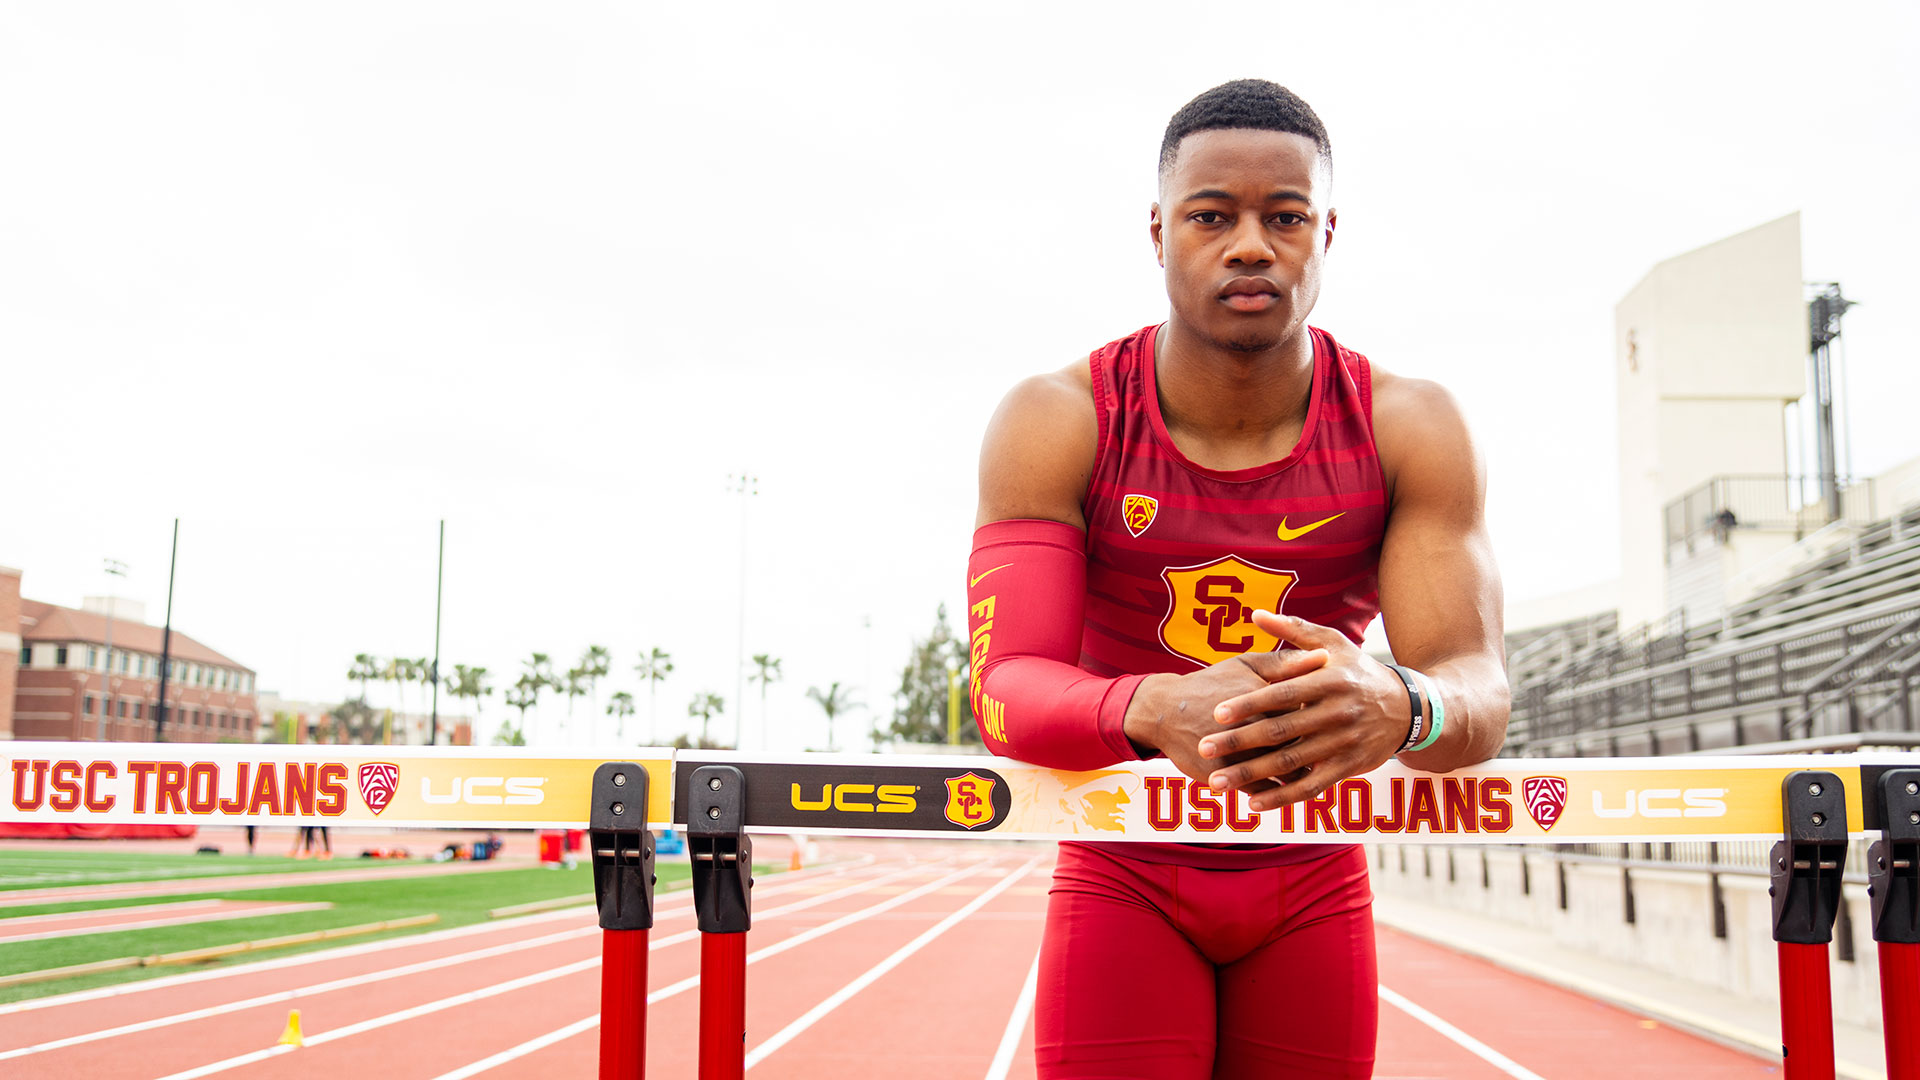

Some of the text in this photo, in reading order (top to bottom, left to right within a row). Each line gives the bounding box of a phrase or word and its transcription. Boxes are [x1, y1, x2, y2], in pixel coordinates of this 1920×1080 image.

[1125, 497, 1156, 522] PAC
[1129, 513, 1147, 529] 12
[981, 693, 1008, 744] ON!
[12, 759, 349, 817] USC TROJANS
[360, 764, 398, 793] PAC
[421, 776, 546, 805] UCS
[1524, 777, 1567, 808] PAC
[369, 789, 387, 806] 12
[790, 783, 917, 813] UCS
[1144, 776, 1261, 832] USC
[1591, 788, 1728, 818] UCS
[1536, 804, 1555, 821] 12
